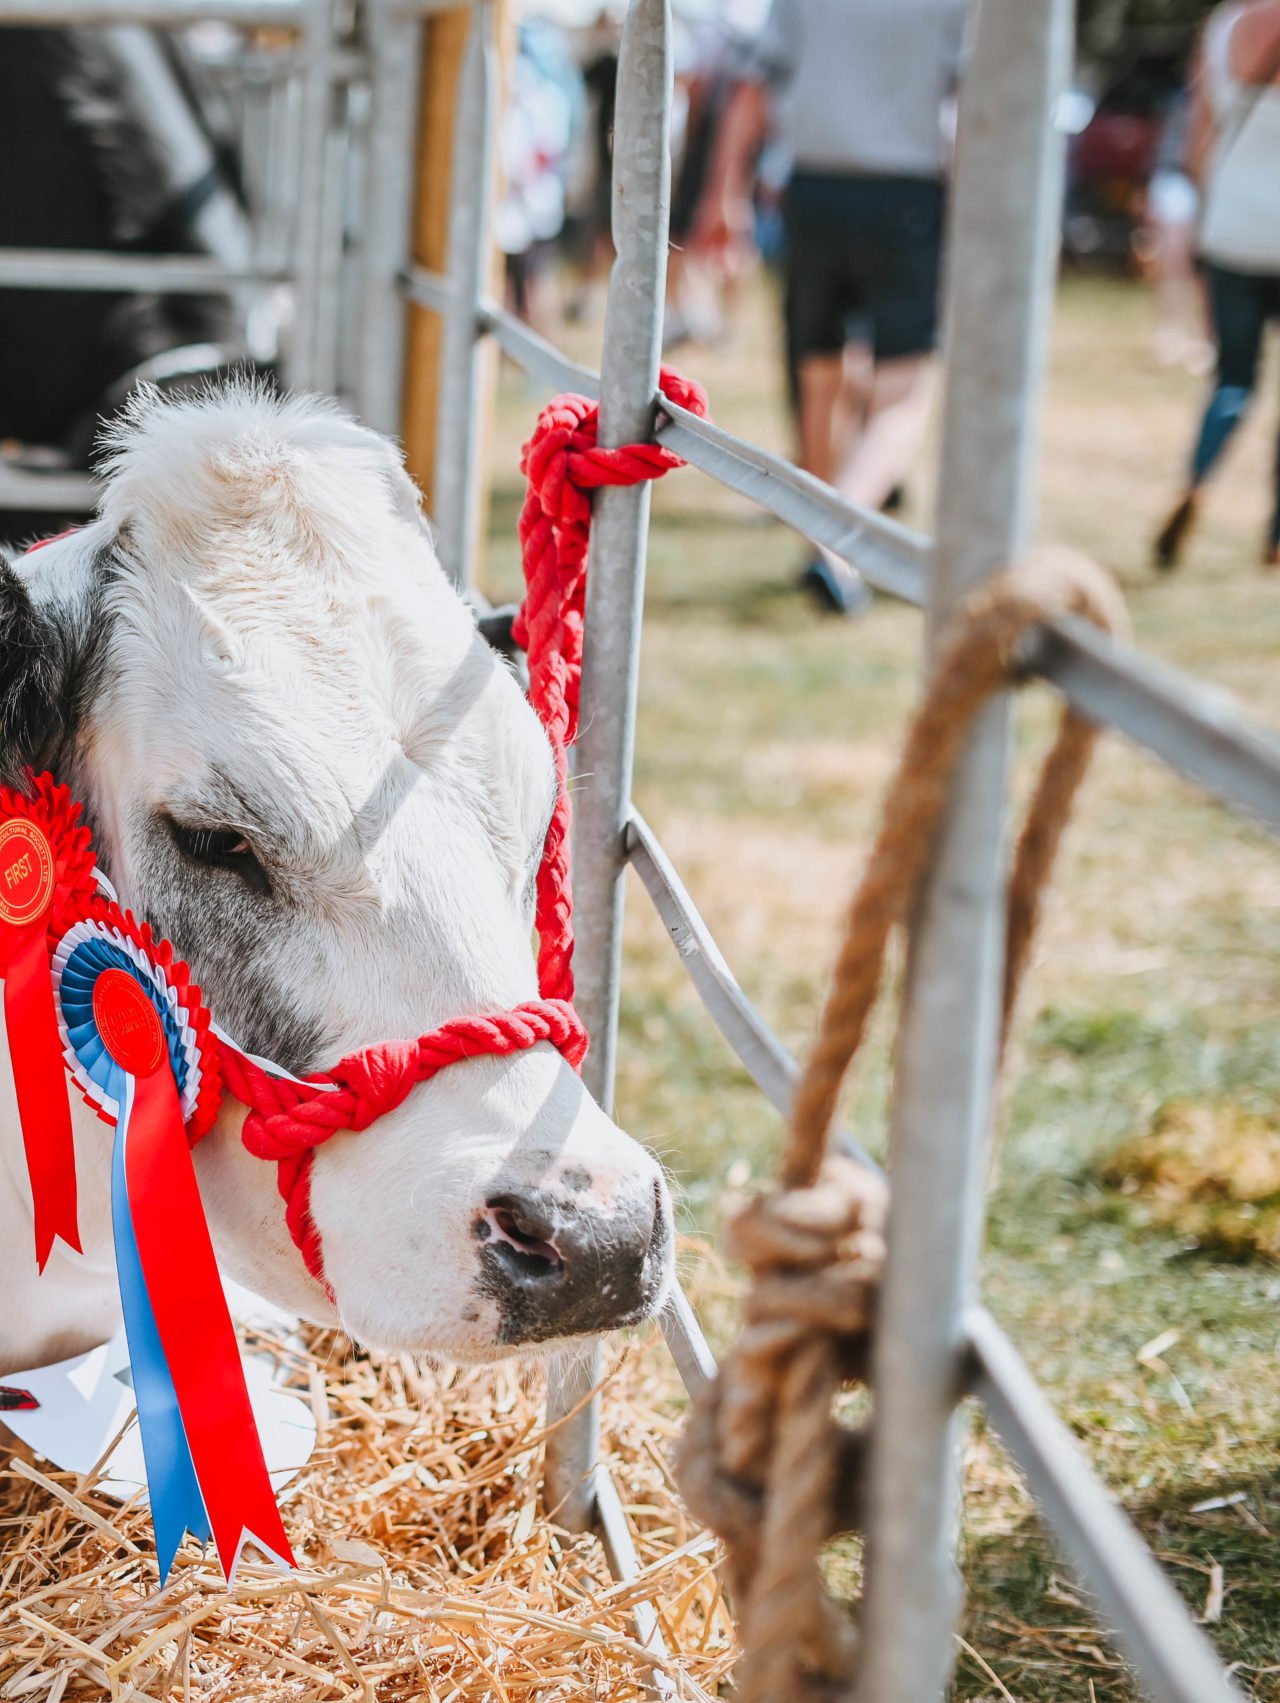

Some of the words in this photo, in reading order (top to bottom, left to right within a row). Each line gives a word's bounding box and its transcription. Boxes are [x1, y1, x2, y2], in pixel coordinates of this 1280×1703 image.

[0, 900, 10, 914] THE
[29, 831, 47, 861] SOCIETY
[4, 852, 33, 890] FIRST
